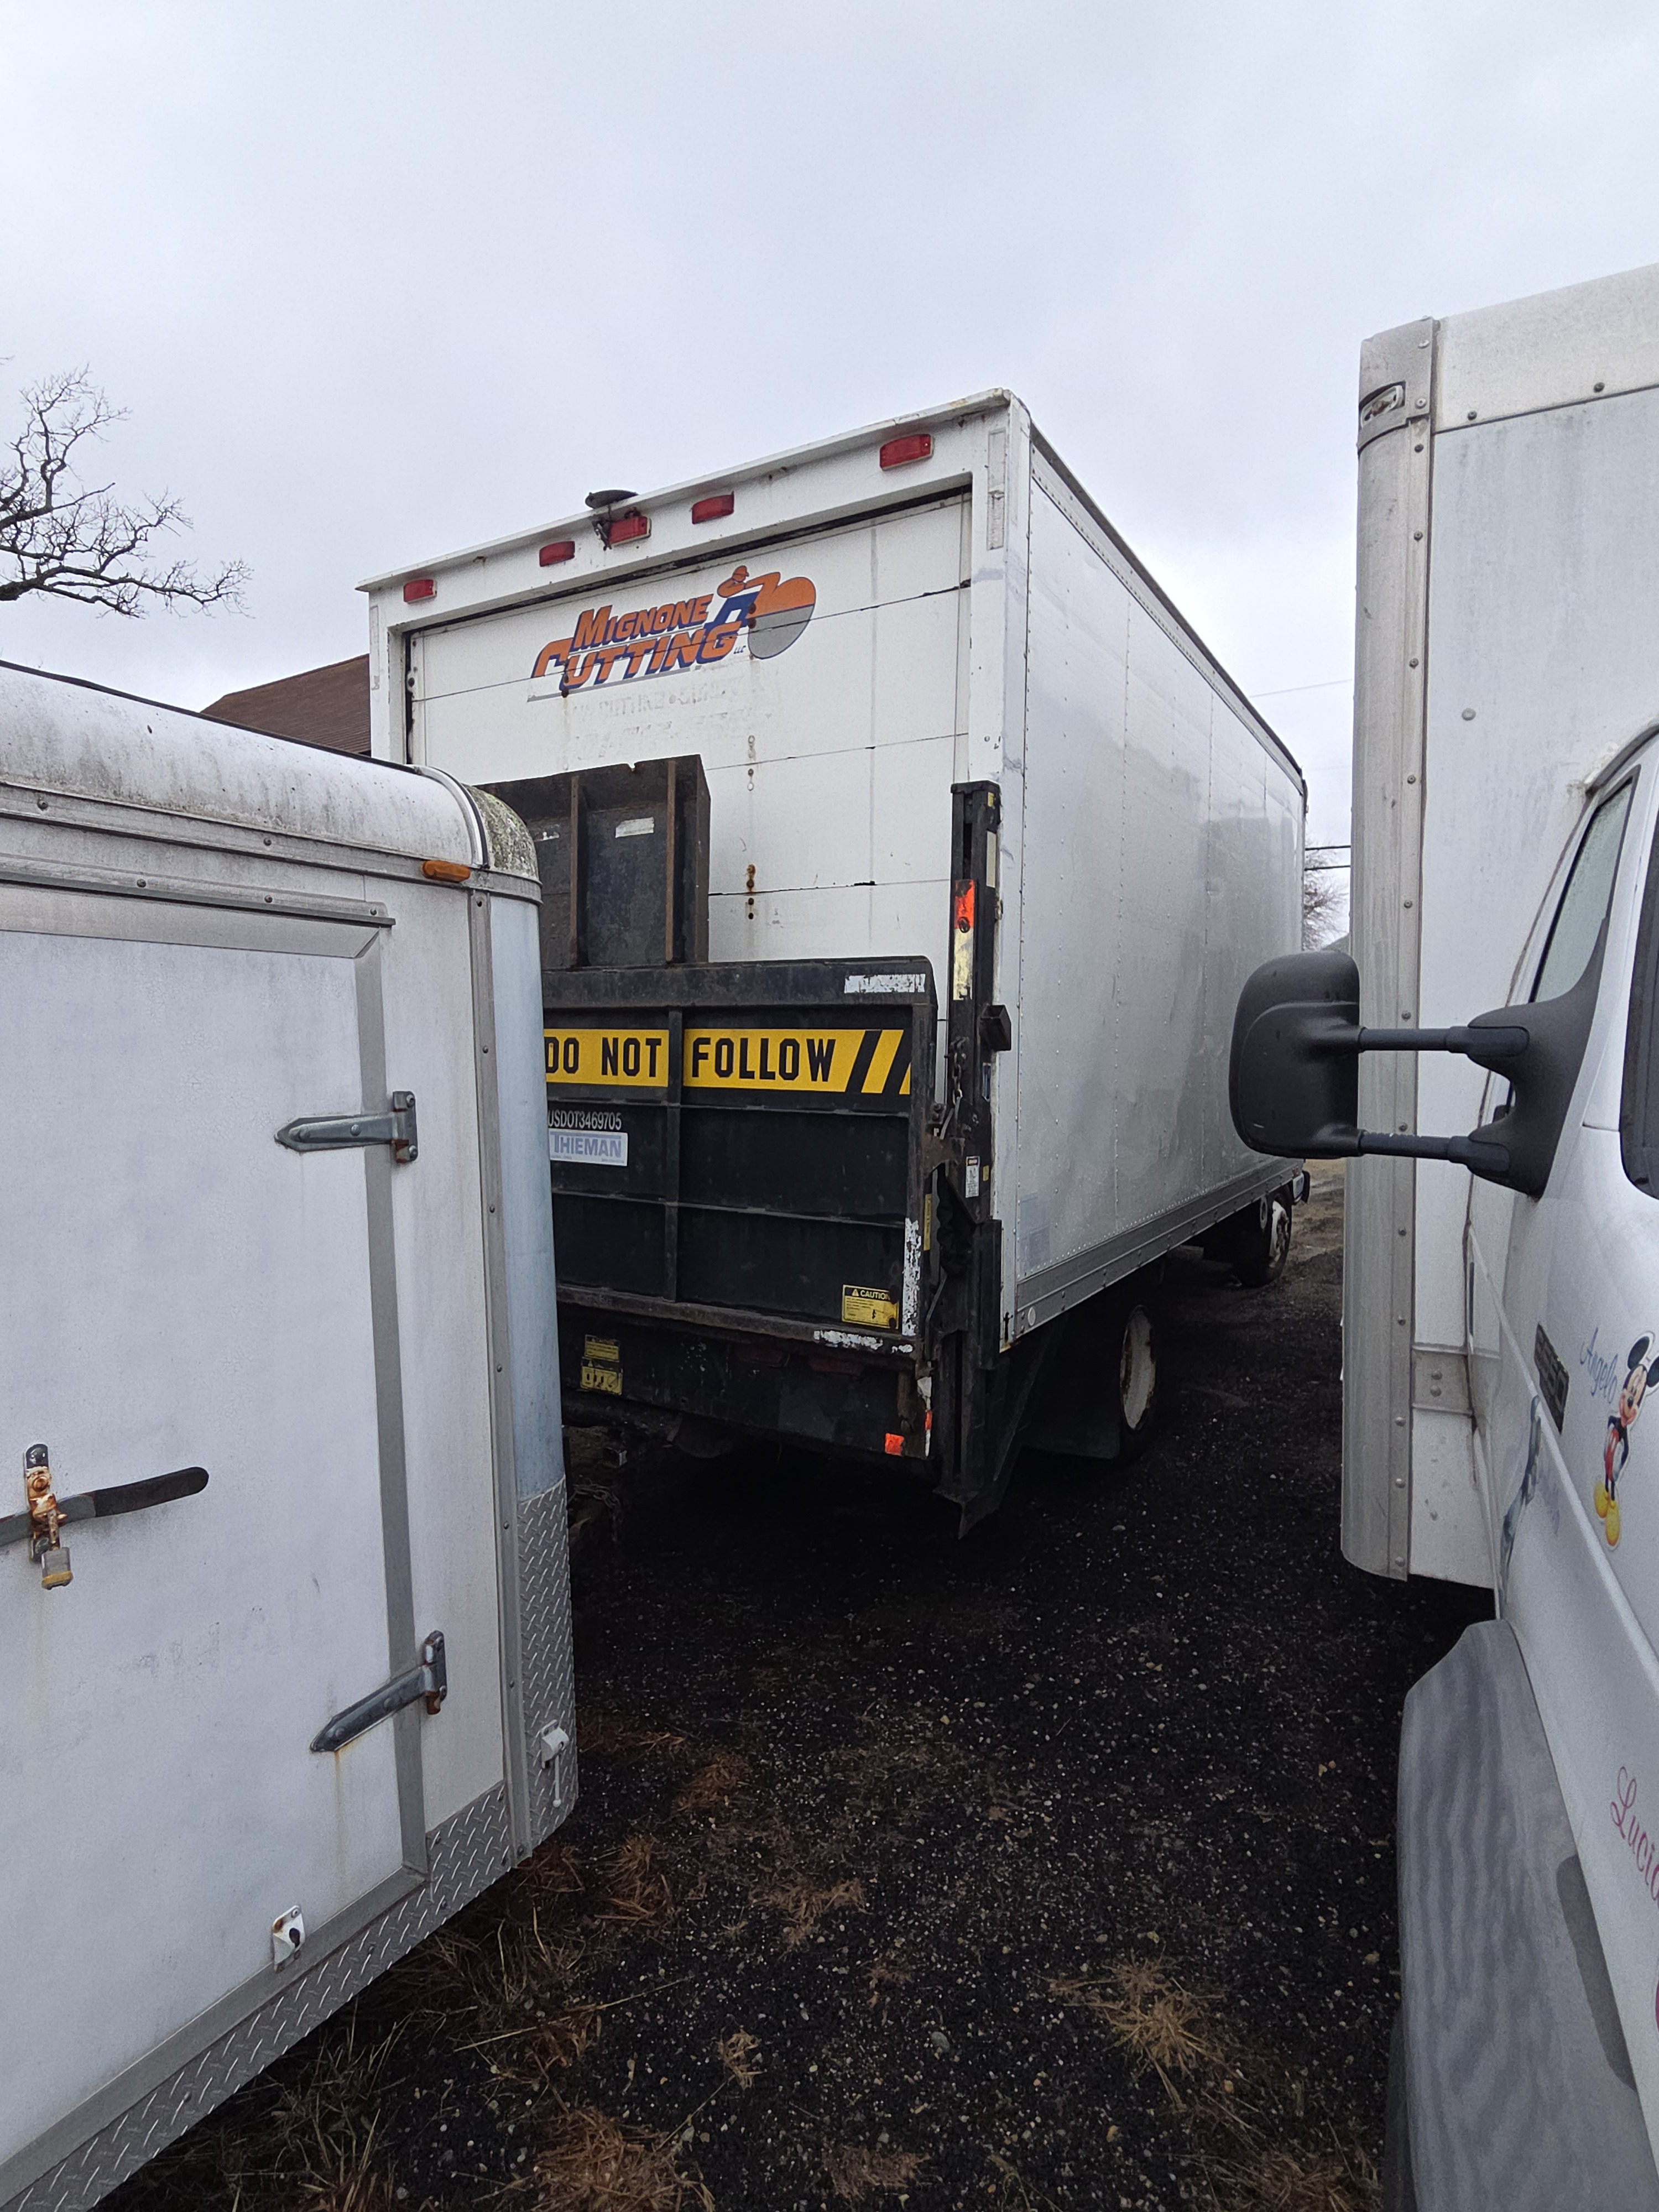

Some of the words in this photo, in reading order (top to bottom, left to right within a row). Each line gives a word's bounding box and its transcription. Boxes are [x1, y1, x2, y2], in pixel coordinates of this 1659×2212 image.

[572, 593, 713, 650] MIGNONE
[531, 621, 742, 691] CUTTING
[544, 1036, 580, 1074] DO
[601, 1037, 662, 1078] NOT
[691, 1037, 836, 1082] FOLLOW
[548, 1109, 622, 1130] USDOT3469705
[550, 1131, 622, 1158] THIEMAN
[1580, 1327, 1618, 1404] Angelo
